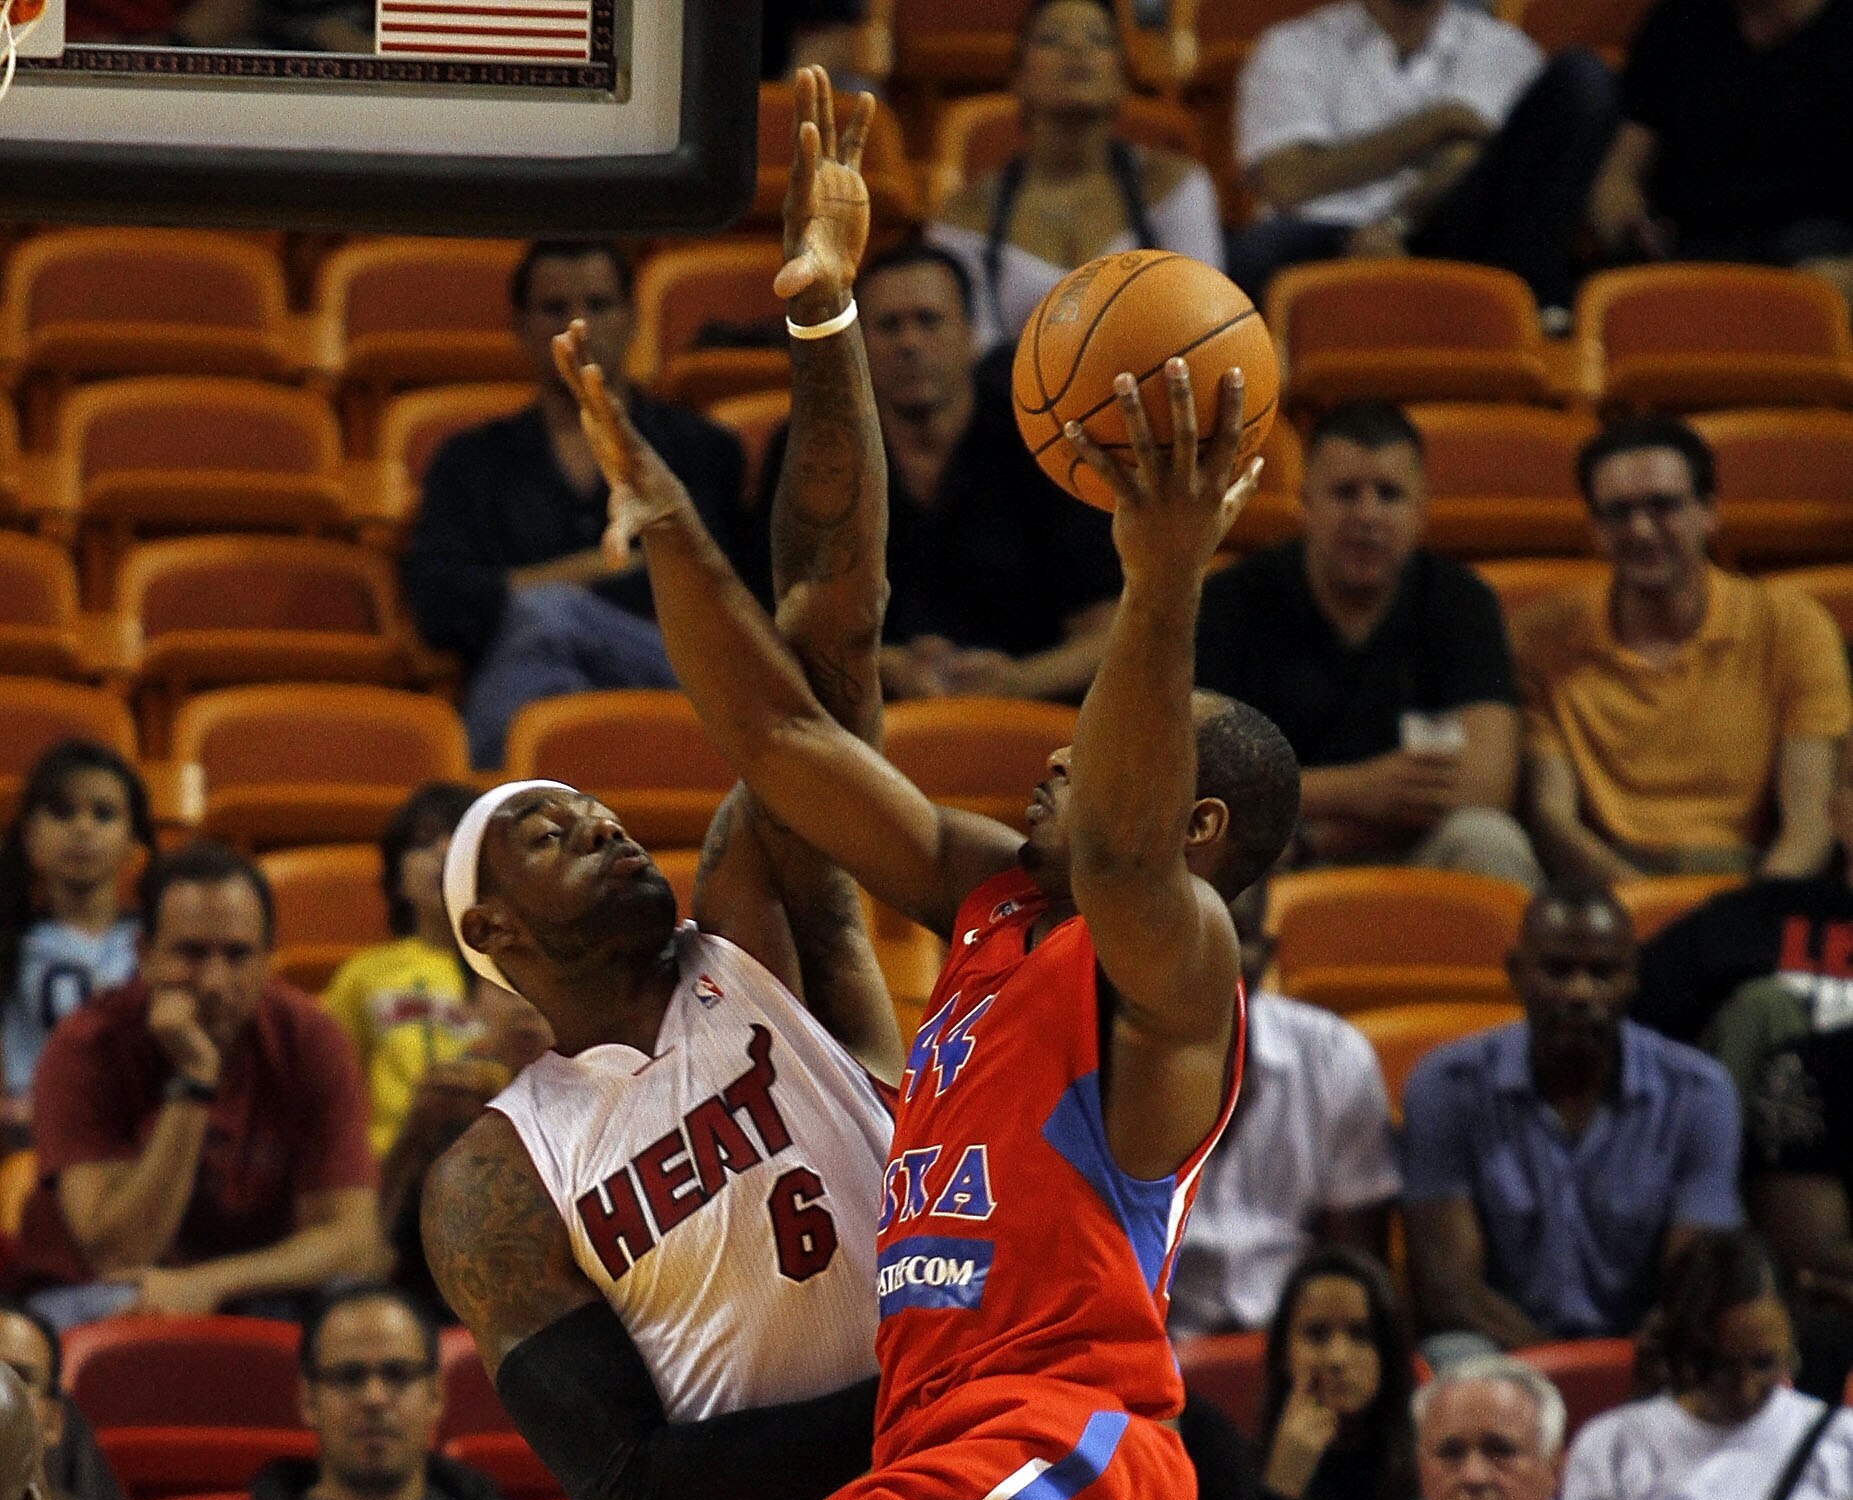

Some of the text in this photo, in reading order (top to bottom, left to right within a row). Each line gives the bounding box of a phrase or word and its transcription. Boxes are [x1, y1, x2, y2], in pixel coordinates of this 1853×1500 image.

[904, 990, 1000, 1103] 44
[576, 1022, 795, 1283] HEAT
[767, 1165, 839, 1284] 6
